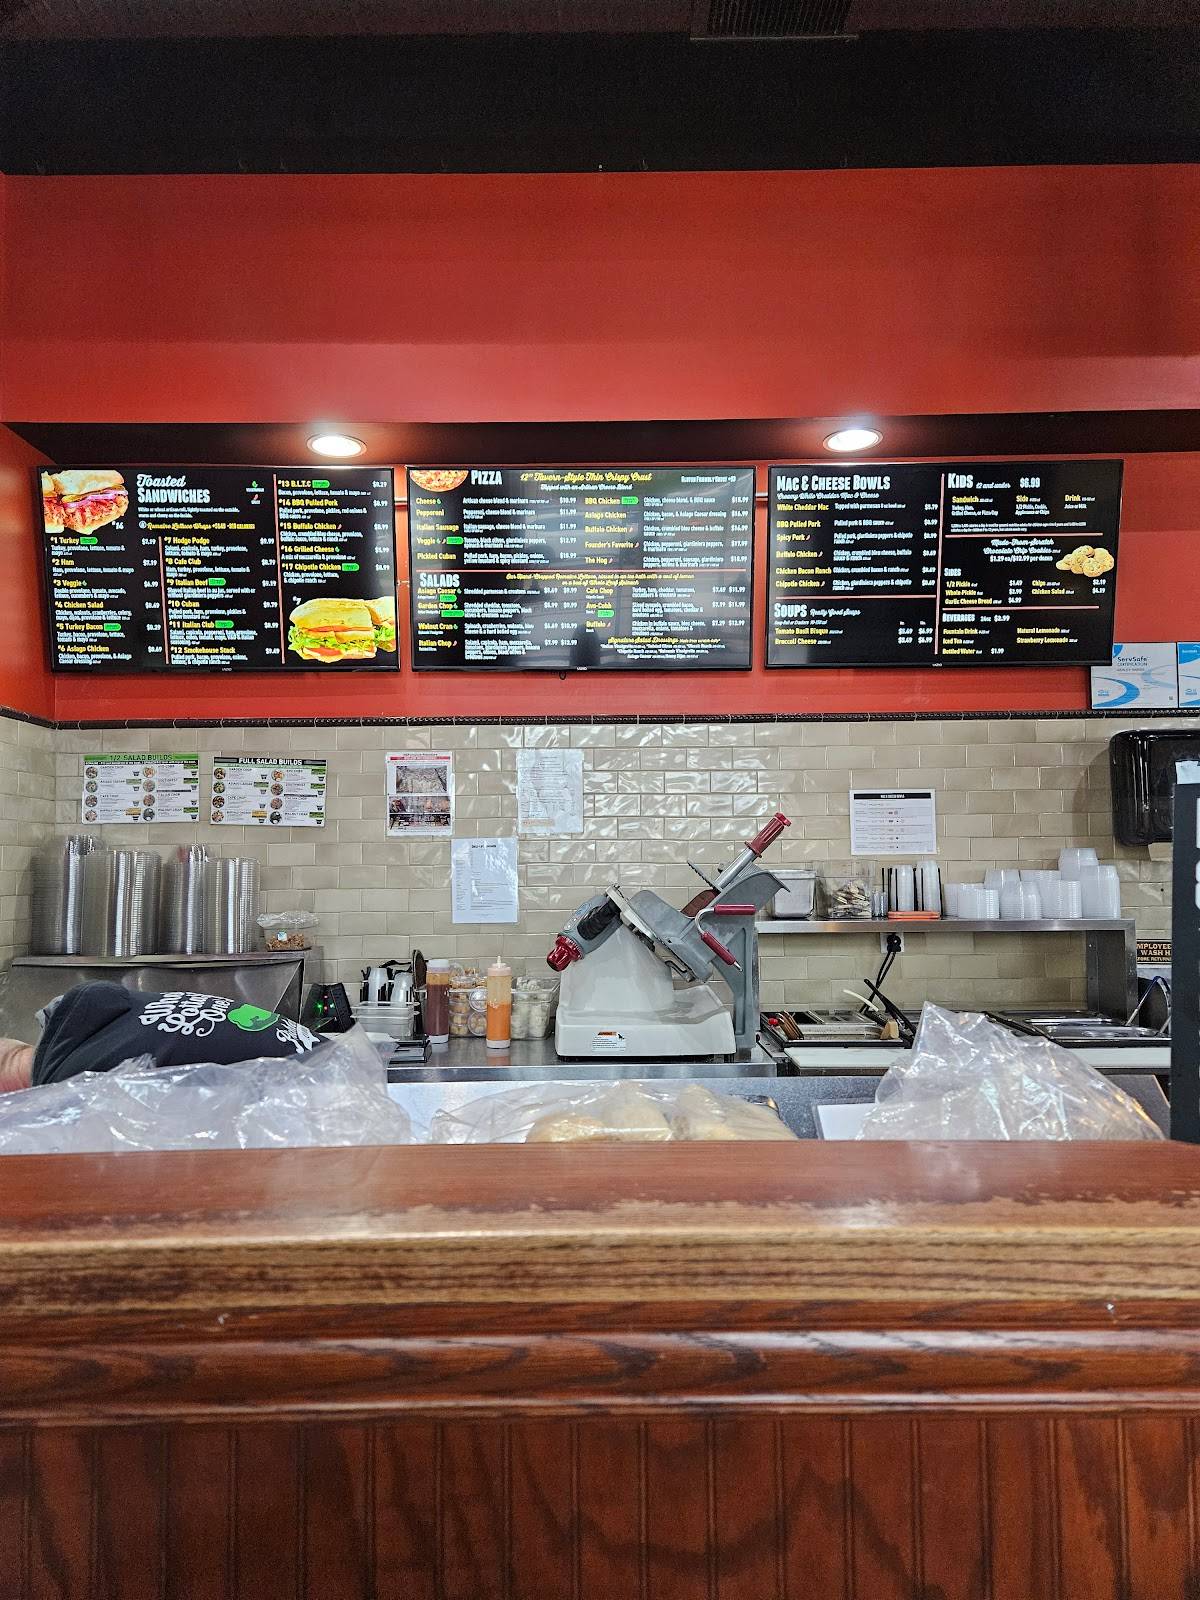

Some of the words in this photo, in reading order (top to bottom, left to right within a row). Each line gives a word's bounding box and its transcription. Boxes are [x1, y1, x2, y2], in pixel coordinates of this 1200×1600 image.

[137, 474, 186, 487] Toasted
[471, 470, 502, 485] PIZZA
[777, 476, 799, 491] MAC
[801, 475, 809, 490] &
[811, 475, 851, 490] CHEESE
[853, 475, 890, 490] BOWLS
[948, 473, 973, 488] KIDS
[138, 488, 210, 503] SANDWICHES
[776, 534, 791, 542] Spicy
[944, 568, 961, 576] SIDES
[420, 573, 460, 587] SALADS
[774, 603, 807, 617] SOUPS
[943, 614, 975, 622] BEVERAGES
